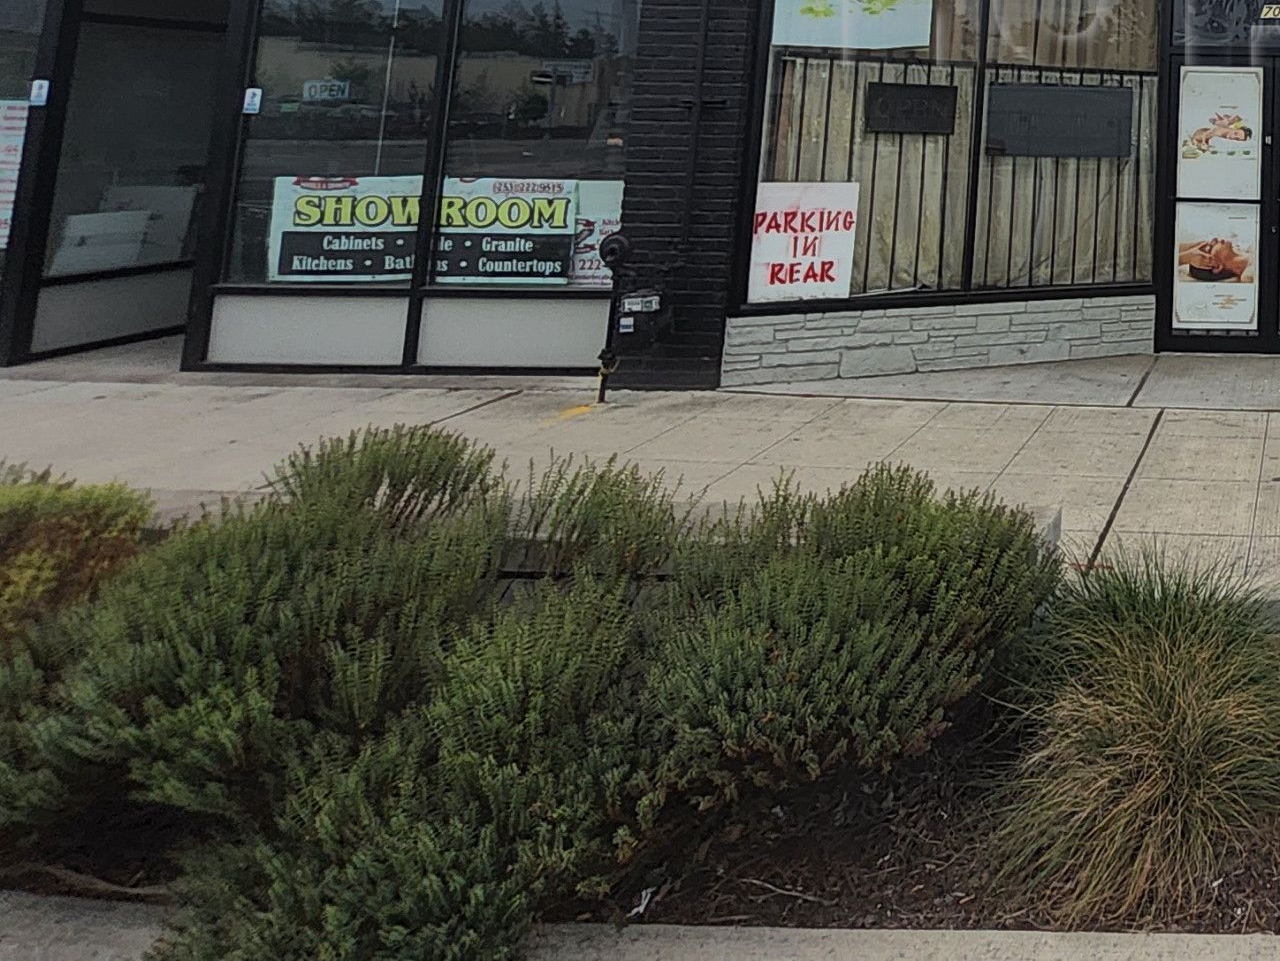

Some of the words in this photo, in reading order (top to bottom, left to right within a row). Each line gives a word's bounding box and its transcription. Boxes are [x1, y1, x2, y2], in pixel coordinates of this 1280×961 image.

[308, 84, 347, 99] OPEN
[753, 209, 855, 235] PARKING
[322, 235, 384, 250] Cabinets
[482, 237, 534, 252] Granite
[792, 235, 818, 258] IN
[292, 255, 353, 271] Kitchens
[477, 259, 562, 275] Countertops
[768, 260, 836, 286] REAR
